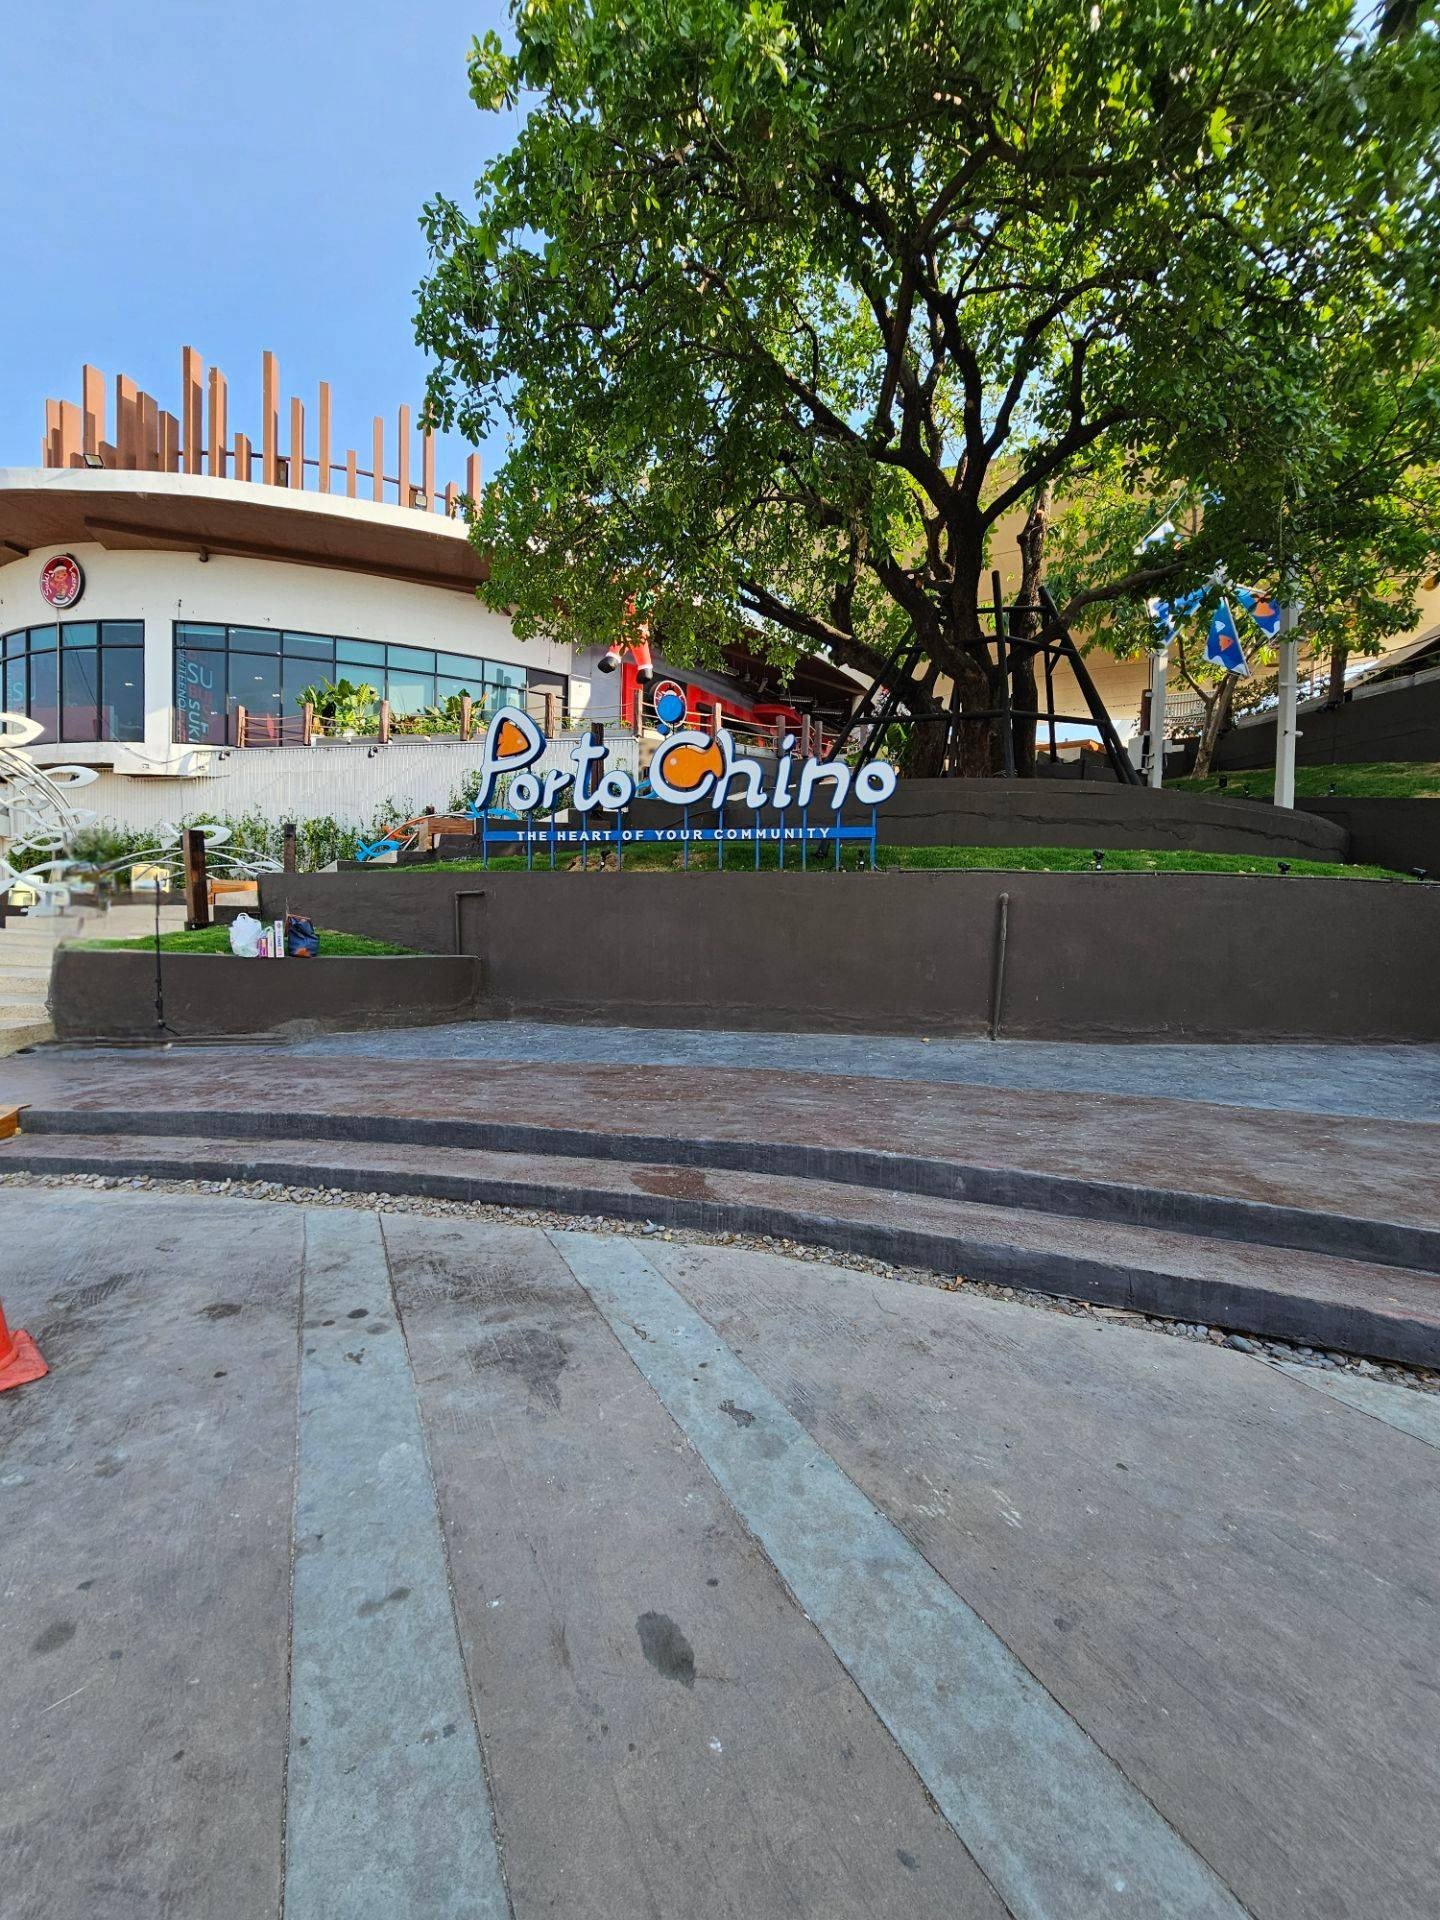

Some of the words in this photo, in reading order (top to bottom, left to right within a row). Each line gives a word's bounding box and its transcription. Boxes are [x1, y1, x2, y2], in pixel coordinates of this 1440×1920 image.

[475, 705, 634, 812] Porto
[650, 728, 897, 809] Chino
[516, 831, 547, 841] THE
[557, 831, 612, 841] HEART
[622, 830, 644, 841] OF
[655, 829, 703, 841] YOUR
[714, 828, 830, 840] COMMUNITY
